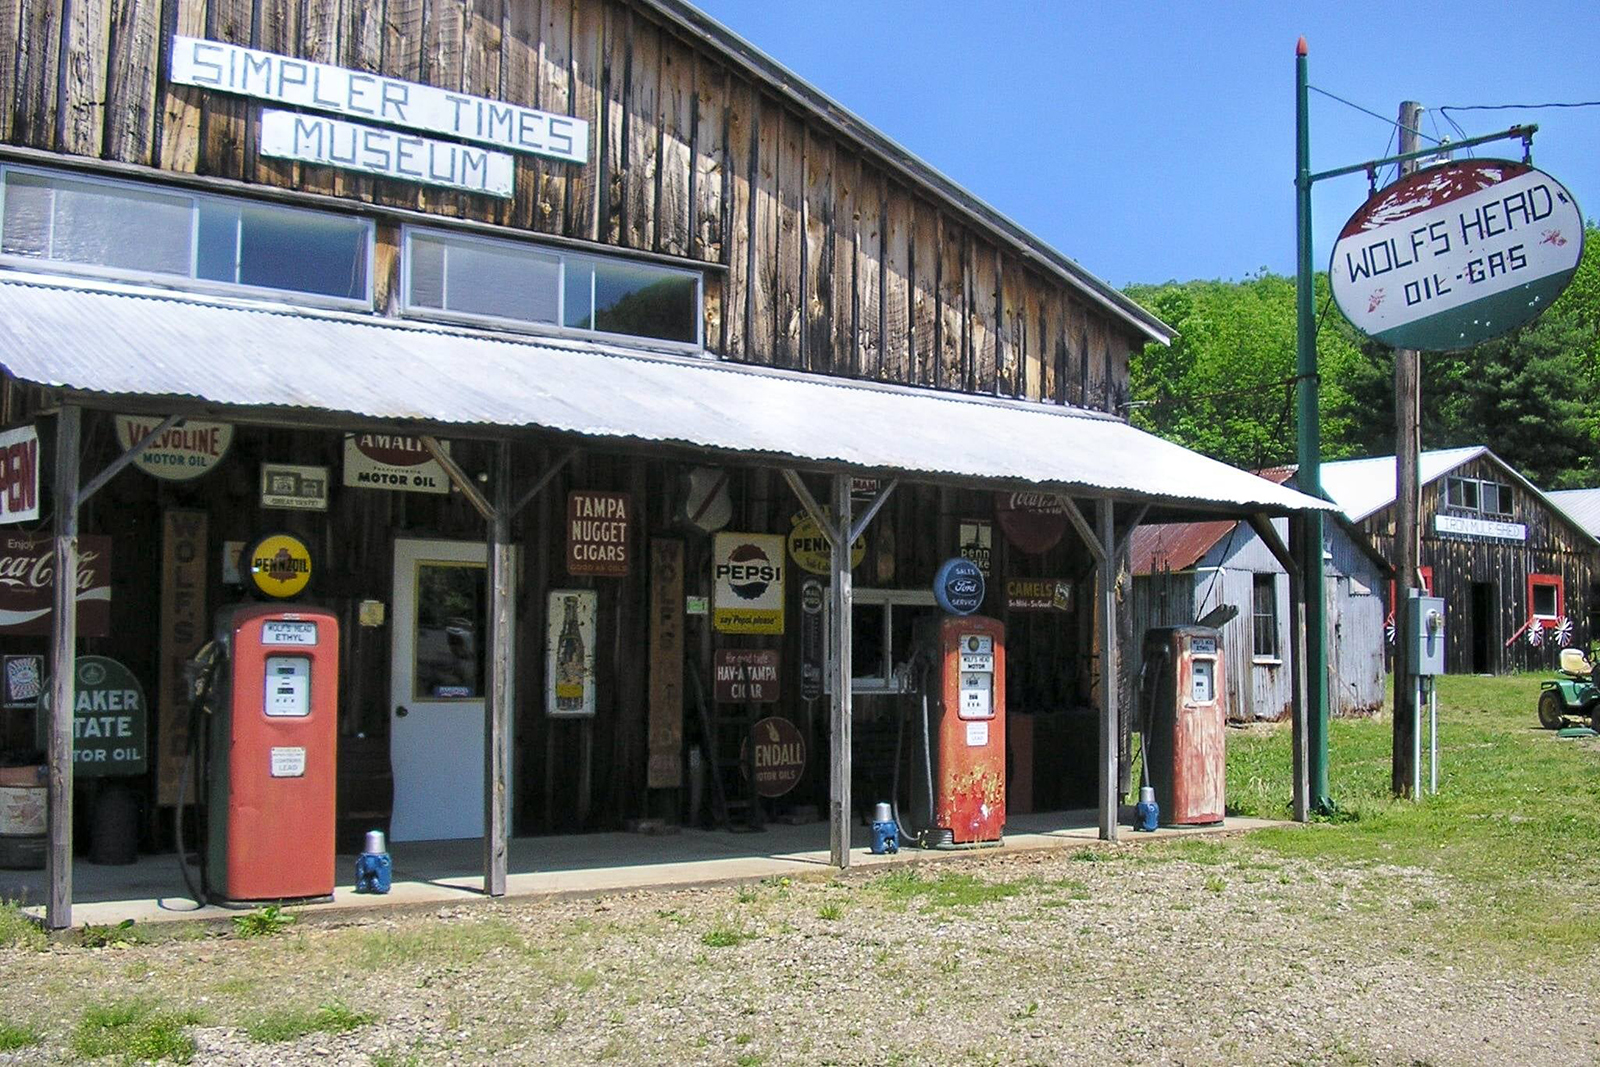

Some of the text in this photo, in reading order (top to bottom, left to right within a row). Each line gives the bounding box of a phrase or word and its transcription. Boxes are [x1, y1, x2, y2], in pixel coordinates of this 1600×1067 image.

[191, 43, 574, 155] SIMPLER TIMES
[293, 117, 489, 190] MUSEUM
[1346, 184, 1554, 283] WOLFS HEAD
[360, 433, 429, 452] AMALI
[143, 453, 207, 467] MOTOR OIL
[0, 438, 37, 514] PEN
[358, 472, 436, 488] MOTOR OIL
[574, 496, 626, 519] TAMPA
[572, 520, 627, 543] NUGGET
[1444, 517, 1469, 532] IRON
[8, 538, 36, 551] Enjoy
[573, 544, 625, 561] CIGARS
[793, 537, 863, 553] PENNL
[255, 558, 309, 573] PENNZOIL
[716, 565, 781, 582] PEPSI
[954, 580, 977, 592] Ford
[1007, 581, 1054, 598] CAMELS
[275, 634, 304, 642] ETHYL
[43, 690, 140, 713] AKER
[72, 716, 133, 739] TATE
[72, 747, 141, 763] TOR OIL
[755, 742, 803, 767] ENDALL
